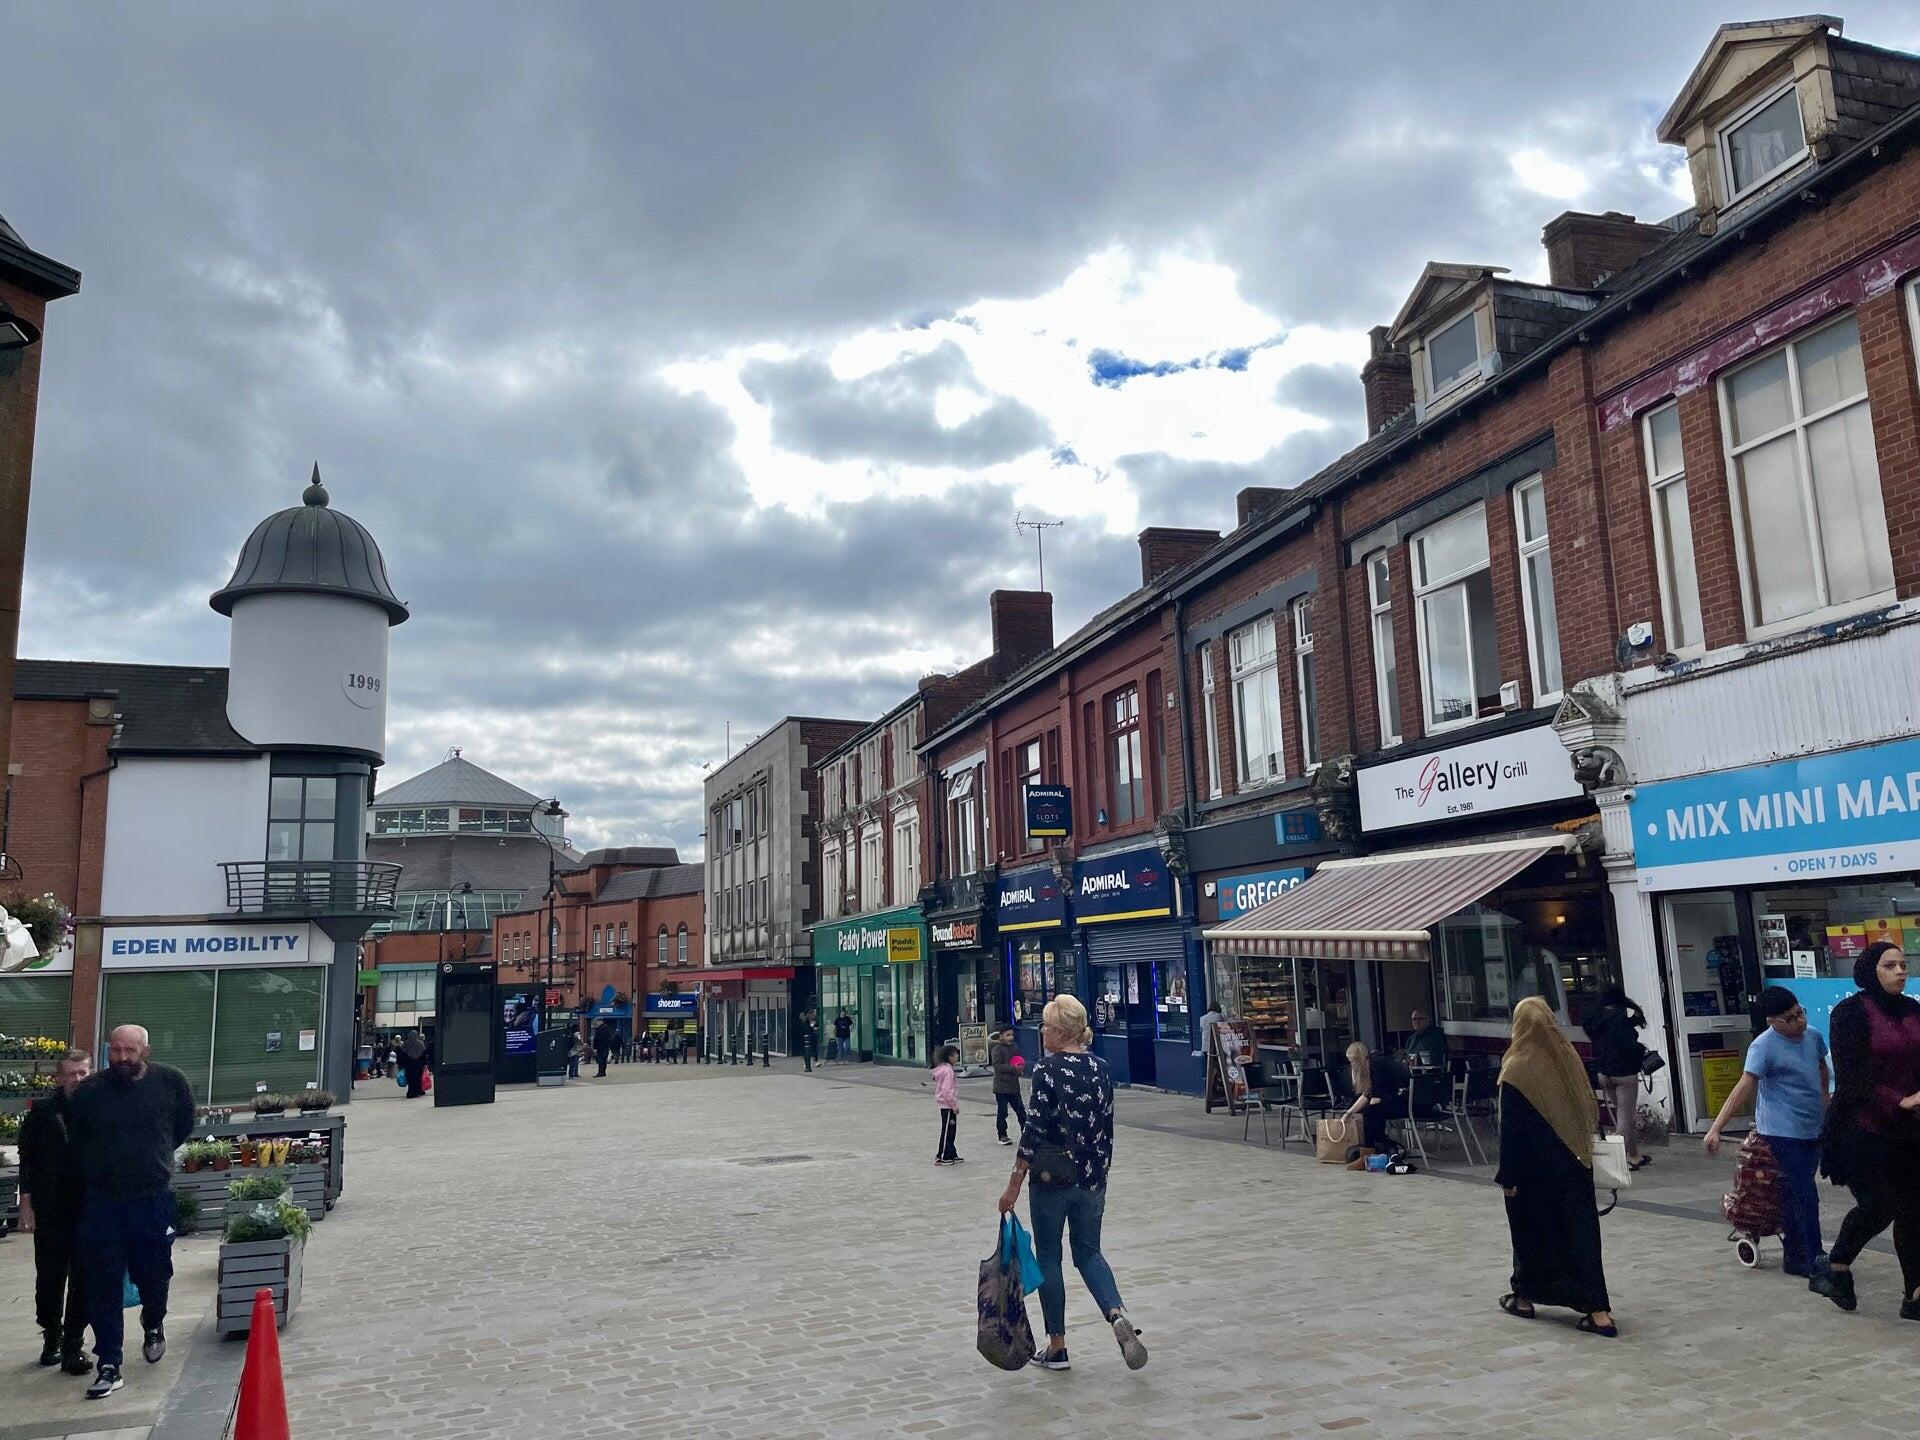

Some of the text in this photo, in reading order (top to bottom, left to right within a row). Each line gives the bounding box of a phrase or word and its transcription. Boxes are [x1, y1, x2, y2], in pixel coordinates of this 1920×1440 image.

[348, 673, 381, 693] 1999
[1394, 756, 1528, 807] The Gallery Grill
[1029, 790, 1065, 798] ADMIRAL
[1447, 802, 1474, 814] Est. 1981
[1666, 800, 1731, 842] MIX
[1738, 786, 1827, 833] MINI
[1787, 852, 1878, 873] OPEN 7 DAYS
[1081, 869, 1131, 896] ADMIRAL
[1645, 876, 1653, 886] 27
[1000, 886, 1036, 908] ADMIRAL
[838, 927, 887, 956] Paddy Power
[932, 920, 978, 942] Poundbakery
[112, 935, 299, 955] EDEN MOBILITY
[657, 998, 681, 1008] shoezon
